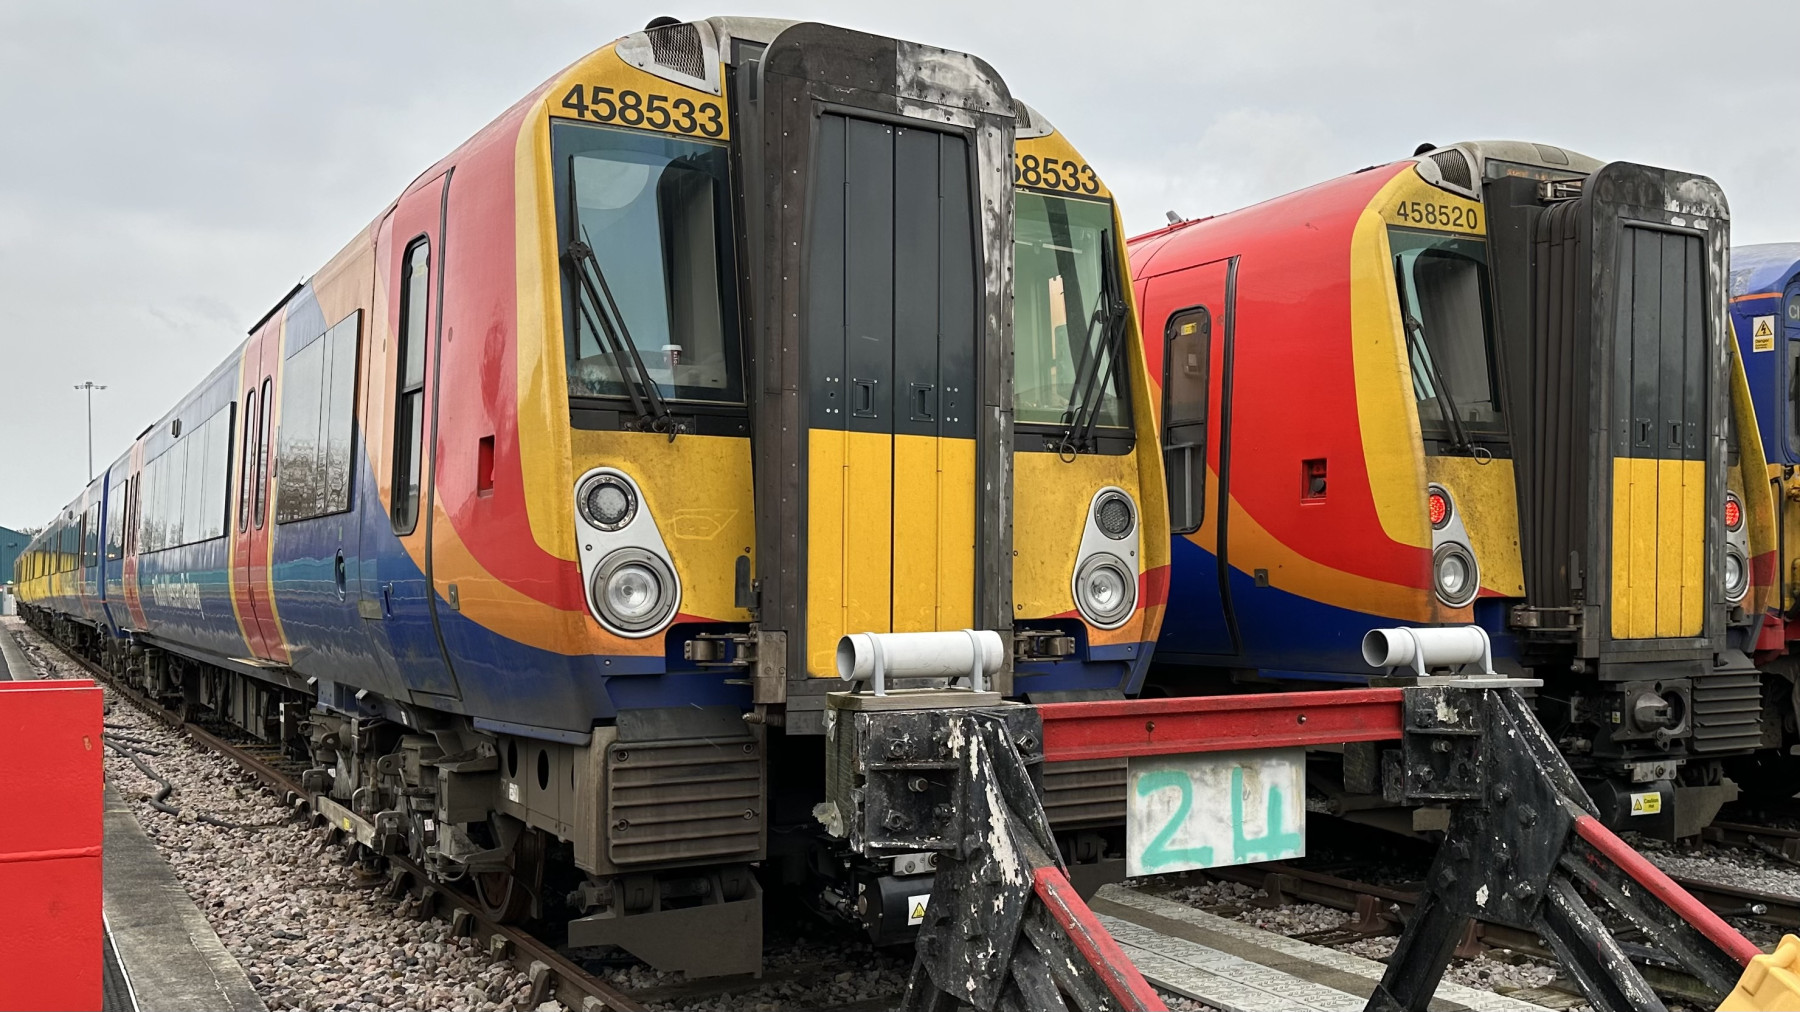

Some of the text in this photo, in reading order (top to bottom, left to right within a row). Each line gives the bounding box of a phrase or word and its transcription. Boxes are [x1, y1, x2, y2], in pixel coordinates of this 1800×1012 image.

[561, 83, 724, 138] 458533
[1396, 200, 1478, 230] 458520
[1136, 766, 1301, 874] 24
